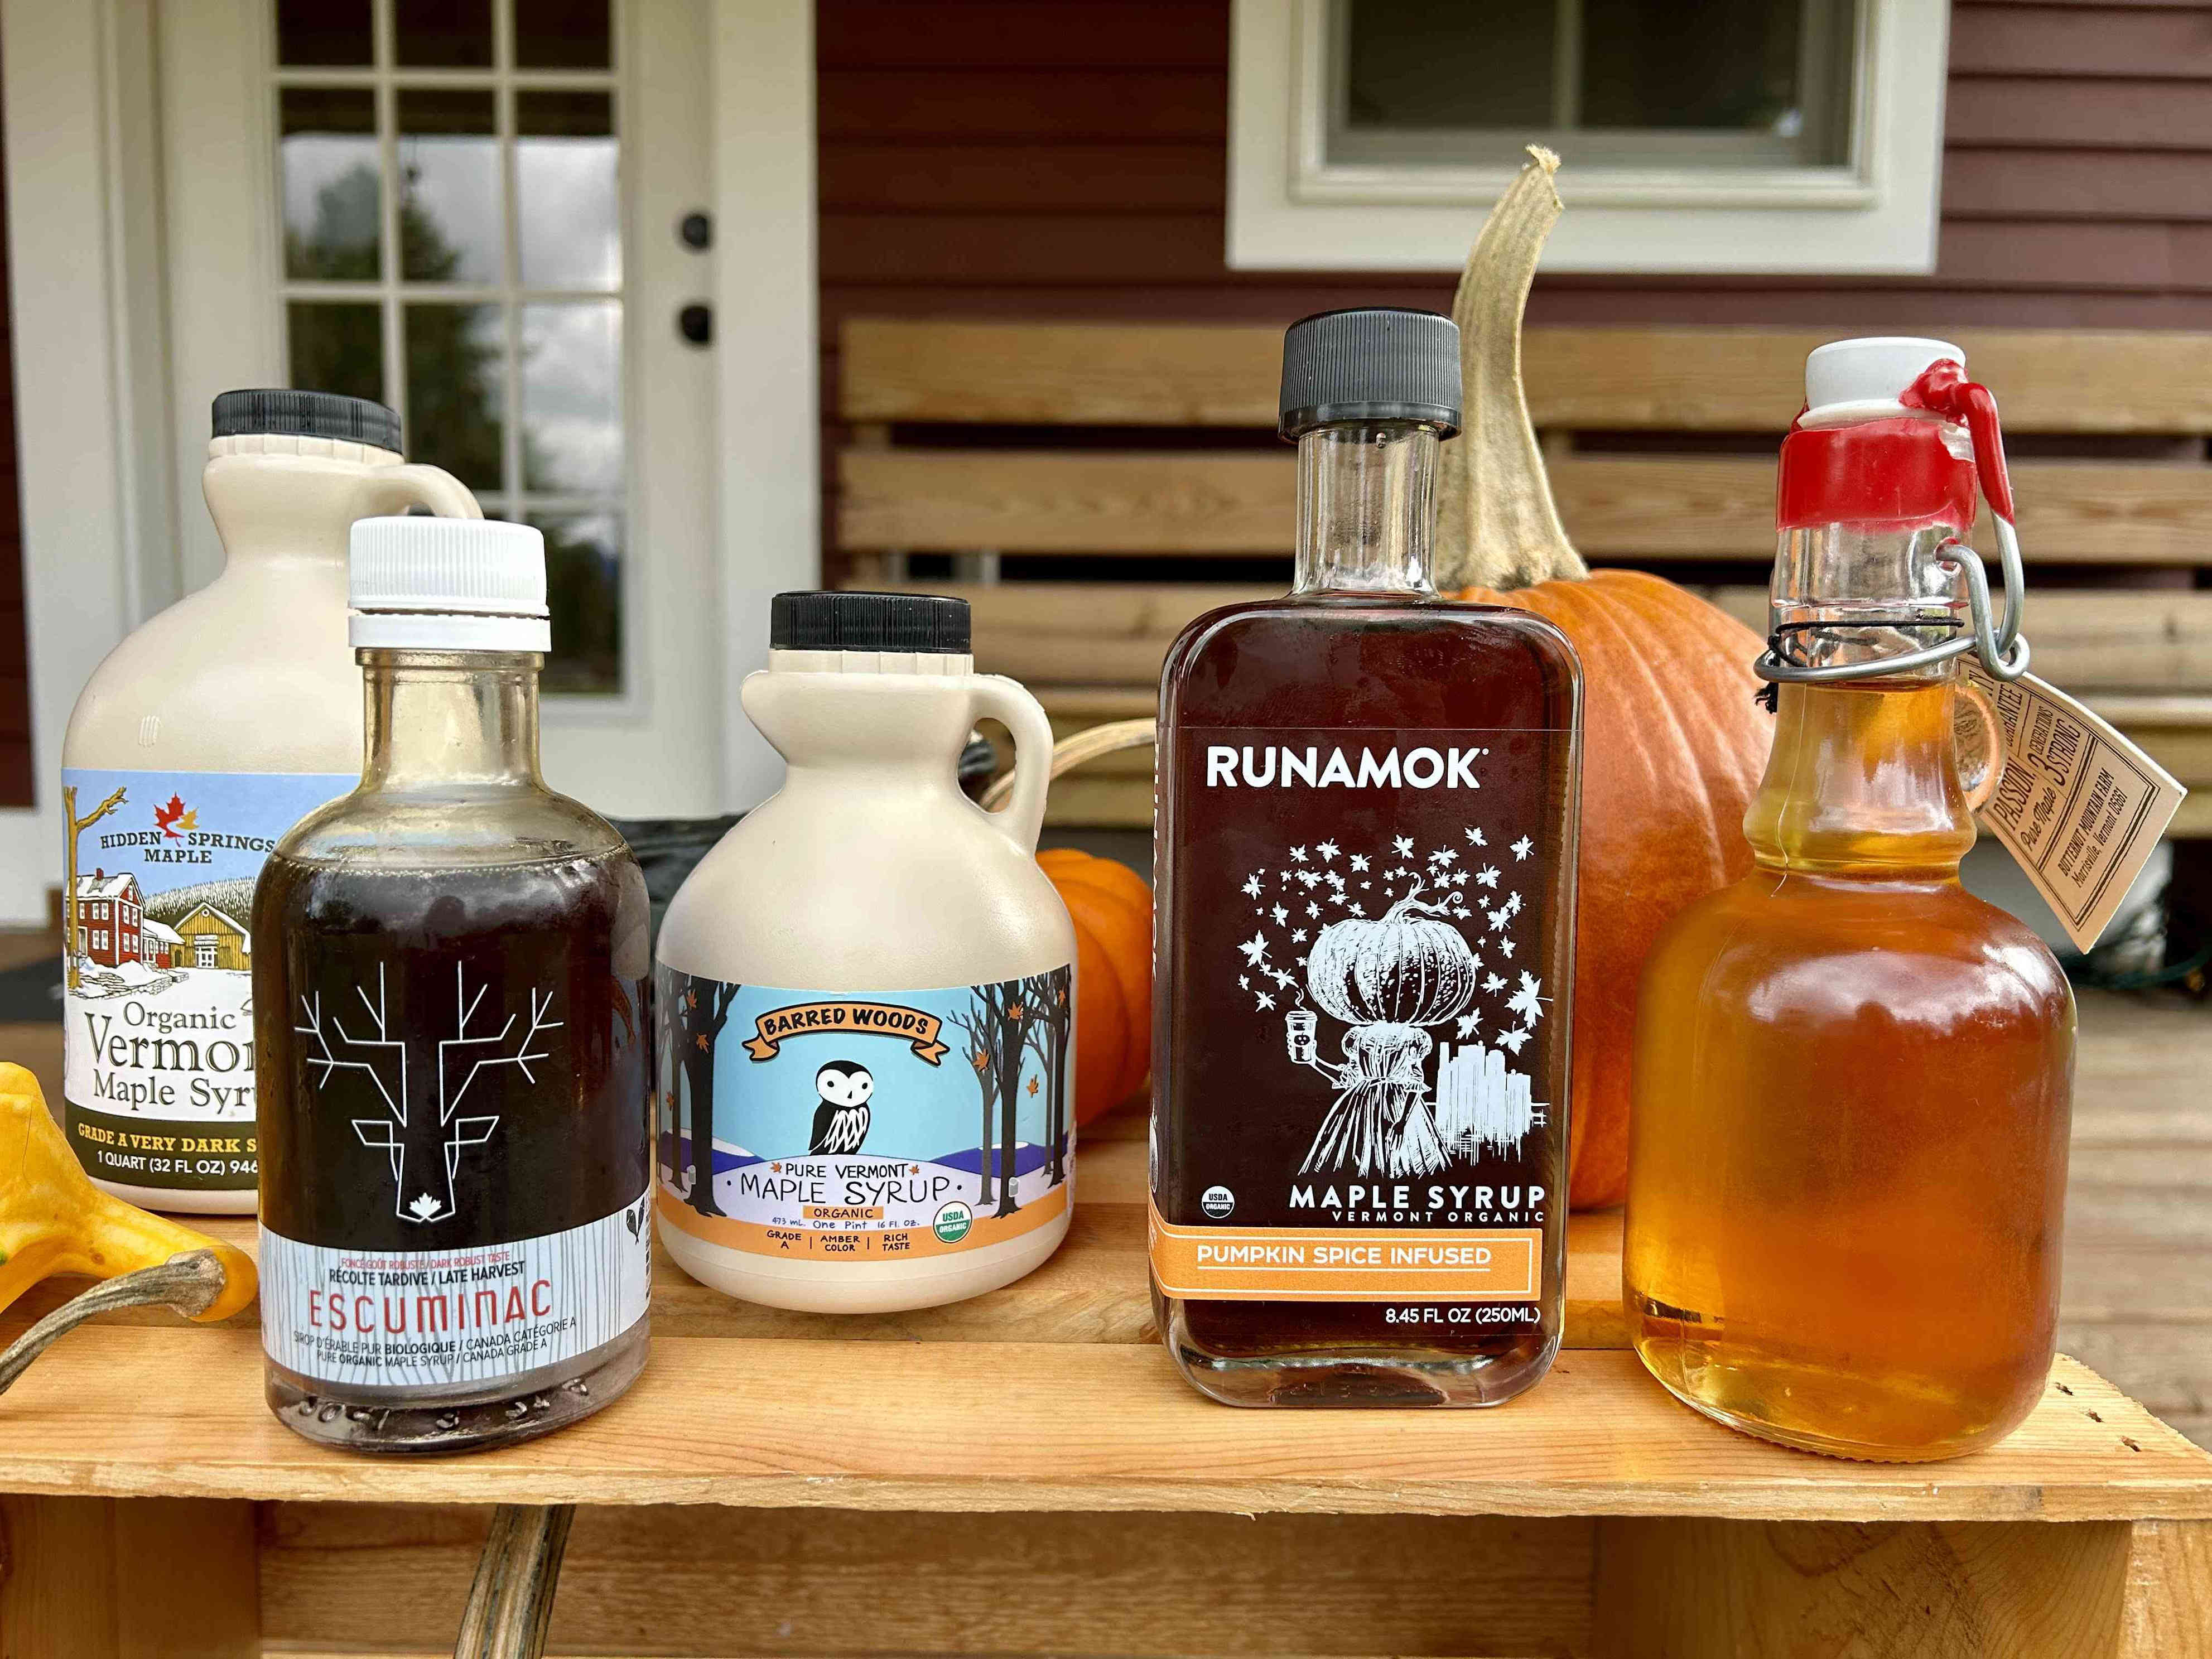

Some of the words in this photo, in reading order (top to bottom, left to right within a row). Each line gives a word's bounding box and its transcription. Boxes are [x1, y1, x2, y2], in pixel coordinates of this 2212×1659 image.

[2029, 706, 2053, 755] GENERATIONS
[2047, 718, 2080, 774] STRONG
[1207, 746, 1481, 789] RUNAMOK
[2027, 753, 2065, 786] 3
[2021, 821, 2041, 851] Pure
[2033, 787, 2056, 824] Maple
[2058, 828, 2086, 876] BUTTERNUT
[2079, 790, 2105, 836] MOUNTAIN
[2095, 768, 2114, 797] FARM
[100, 832, 161, 849] HIDDEN
[188, 832, 276, 852] SPRINGS
[2071, 846, 2102, 888] Morrisville,
[2093, 809, 2117, 846] Vermont
[2108, 786, 2127, 815] 05661
[144, 849, 212, 864] MAPLE
[124, 1001, 237, 1034] Organic
[764, 1007, 846, 1035] BARRED
[852, 1008, 928, 1034] WOODS
[93, 1069, 175, 1111] Maple
[190, 1078, 256, 1115] Syr
[79, 1122, 114, 1145] GRADE
[118, 1134, 127, 1147] A
[129, 1135, 176, 1151] VERY
[181, 1138, 240, 1152] DARK
[98, 1150, 103, 1163] 1
[105, 1151, 146, 1170] QUART
[149, 1159, 171, 1173] (32
[175, 1160, 192, 1173] FL
[196, 1160, 225, 1176] OZ)
[785, 1164, 826, 1178] PURE
[835, 1164, 909, 1179] VERMONT
[741, 1173, 826, 1203] MAPLE
[844, 1176, 950, 1205] SYRUP
[1289, 1184, 1411, 1209] MAPLE
[1428, 1185, 1546, 1210] SYRUP
[813, 1208, 874, 1218] ORGANIC
[845, 1220, 868, 1229] Pint
[943, 1210, 963, 1222] USDA
[1331, 1211, 1434, 1223] VERMONT
[1447, 1211, 1545, 1223] ORGANIC
[767, 1230, 802, 1241] GRADE
[821, 1234, 860, 1243] AMBER
[884, 1234, 908, 1242] RICH
[939, 1223, 967, 1233] ORGANIC
[882, 1242, 910, 1251] TASTE
[1197, 1245, 1305, 1264] PUMPKIN
[1313, 1246, 1381, 1265] SPICE
[1390, 1247, 1492, 1266] INFUSED
[431, 1258, 451, 1269] DARK
[454, 1256, 485, 1269] ROBUST
[488, 1251, 510, 1262] TASTE
[329, 1267, 375, 1286] RÉCOLTE
[380, 1271, 428, 1286] TARDIVE
[439, 1269, 468, 1284] LATE
[471, 1261, 526, 1281] HARVEST
[1385, 1306, 1419, 1324] 8.45
[1424, 1308, 1444, 1323] FL
[1448, 1308, 1471, 1323] OZ
[1475, 1306, 1541, 1325] (250ML)
[294, 1330, 315, 1347] SIROP
[362, 1343, 380, 1353] PUR
[385, 1340, 456, 1356] BIOLOGIQUE
[468, 1334, 511, 1351] CANADA
[570, 1316, 576, 1327] A
[317, 1349, 337, 1362] PURE
[339, 1352, 382, 1366] ORGANIC
[385, 1355, 417, 1367] MAPLE
[420, 1352, 454, 1366] SYRUP
[463, 1348, 504, 1362] CANADA
[507, 1339, 539, 1355] GRADE
[541, 1339, 547, 1349] A
